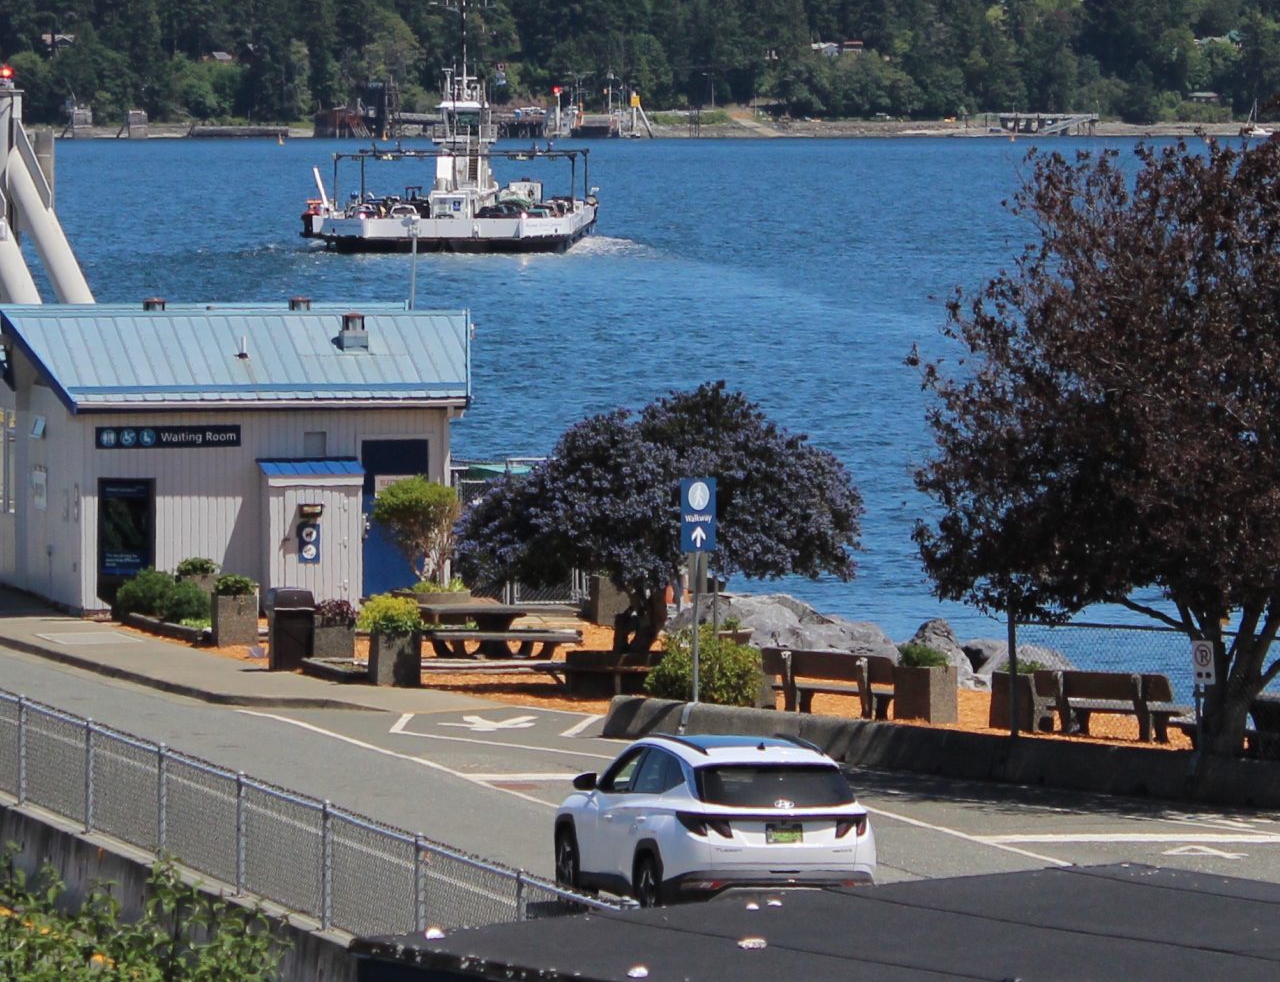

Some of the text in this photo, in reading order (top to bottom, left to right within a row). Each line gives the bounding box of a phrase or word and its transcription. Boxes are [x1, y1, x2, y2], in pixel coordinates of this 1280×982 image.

[161, 431, 237, 444] Waiting Room
[685, 513, 712, 524] Walkway
